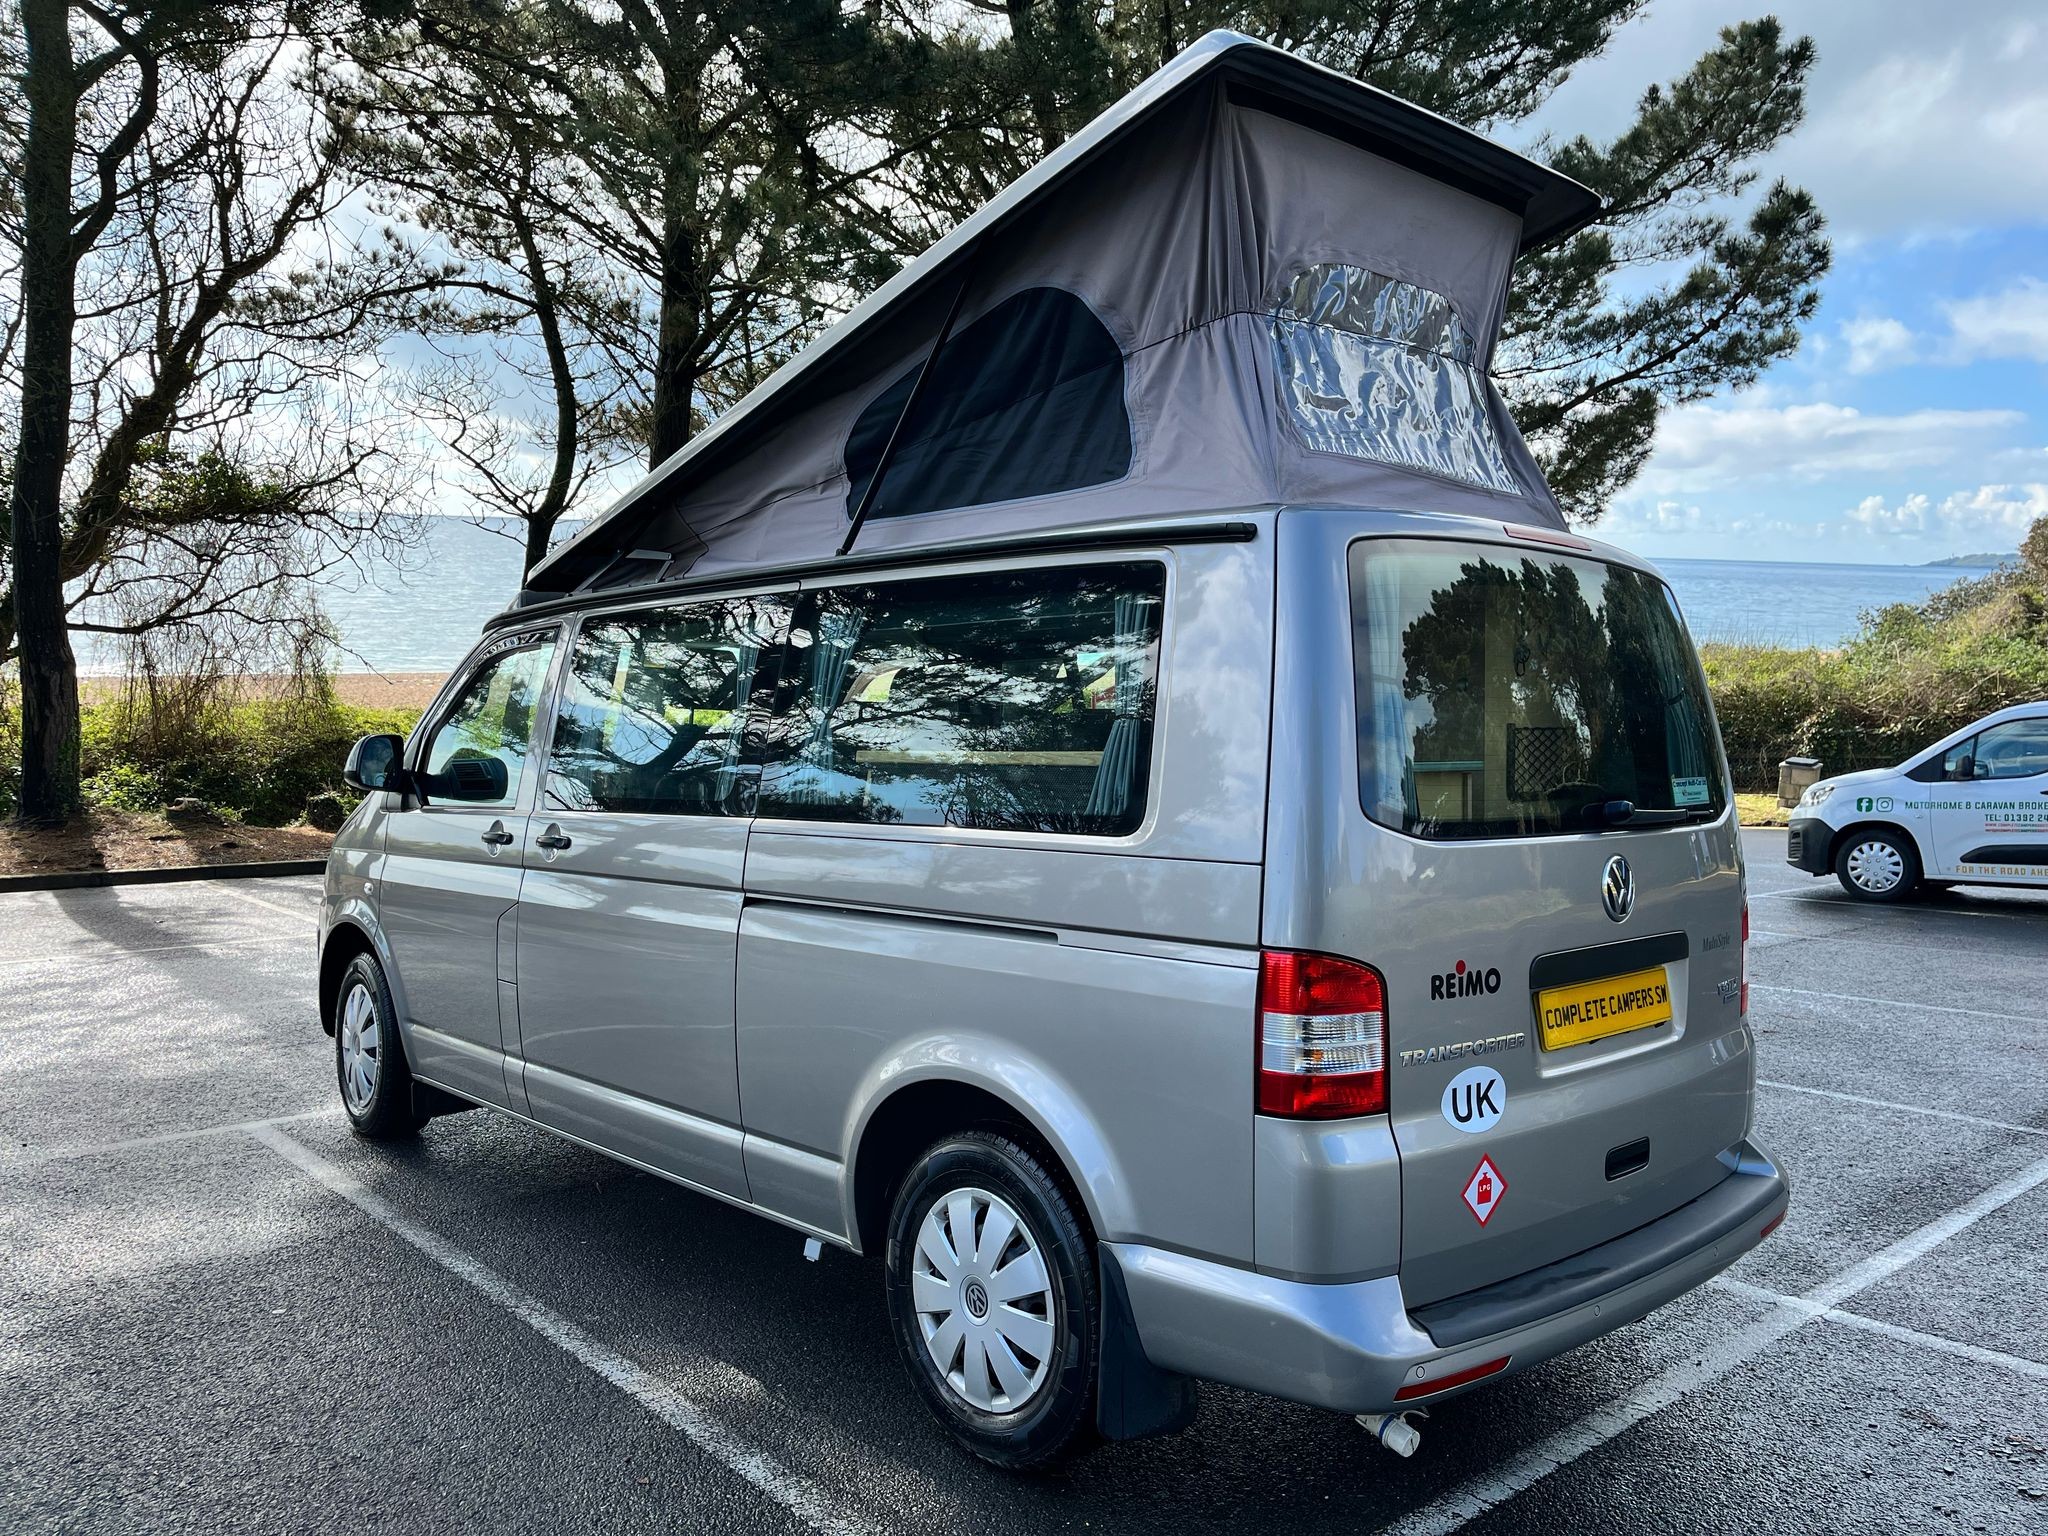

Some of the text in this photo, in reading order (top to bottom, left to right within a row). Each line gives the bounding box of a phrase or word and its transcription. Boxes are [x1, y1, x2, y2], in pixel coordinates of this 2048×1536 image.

[1905, 801, 1962, 810] MOTORHOME
[1975, 801, 2015, 810] CARAVAN
[1984, 813, 2001, 822] TEL:
[2004, 814, 2034, 822] 01392
[1955, 865, 1974, 874] FOR
[1979, 866, 1996, 875] THE
[2000, 866, 2026, 876] ROAD
[1545, 984, 1668, 1030] COMPLETE CAMPERS SW
[1400, 1032, 1526, 1068] TRANSPORTER
[1451, 1078, 1499, 1123] UK
[1479, 1183, 1491, 1192] LPG
